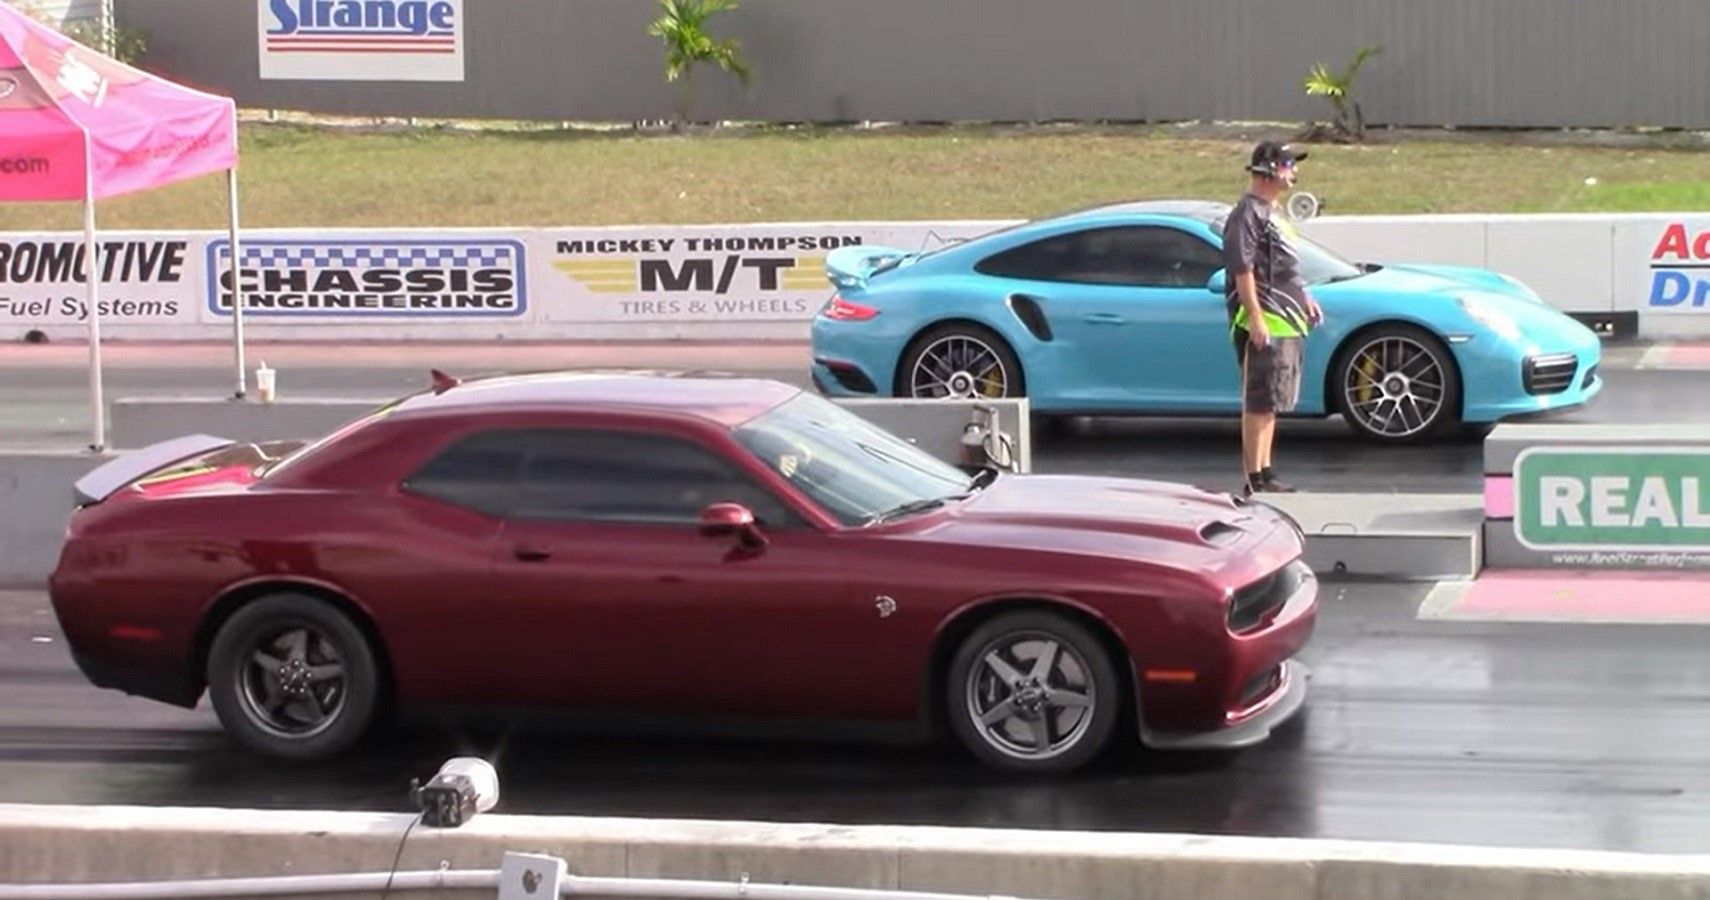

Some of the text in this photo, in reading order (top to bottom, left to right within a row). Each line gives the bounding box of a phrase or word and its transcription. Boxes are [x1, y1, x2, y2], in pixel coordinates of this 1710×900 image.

[556, 235, 862, 254] MICKEY THOMPSON
[219, 269, 514, 293] CHASSIS
[640, 255, 795, 295] M/T
[60, 296, 178, 321] Systems
[221, 294, 514, 308] ENGINEERING
[618, 299, 807, 315] TIRES & WHEELS
[1539, 476, 1710, 528] REAL
